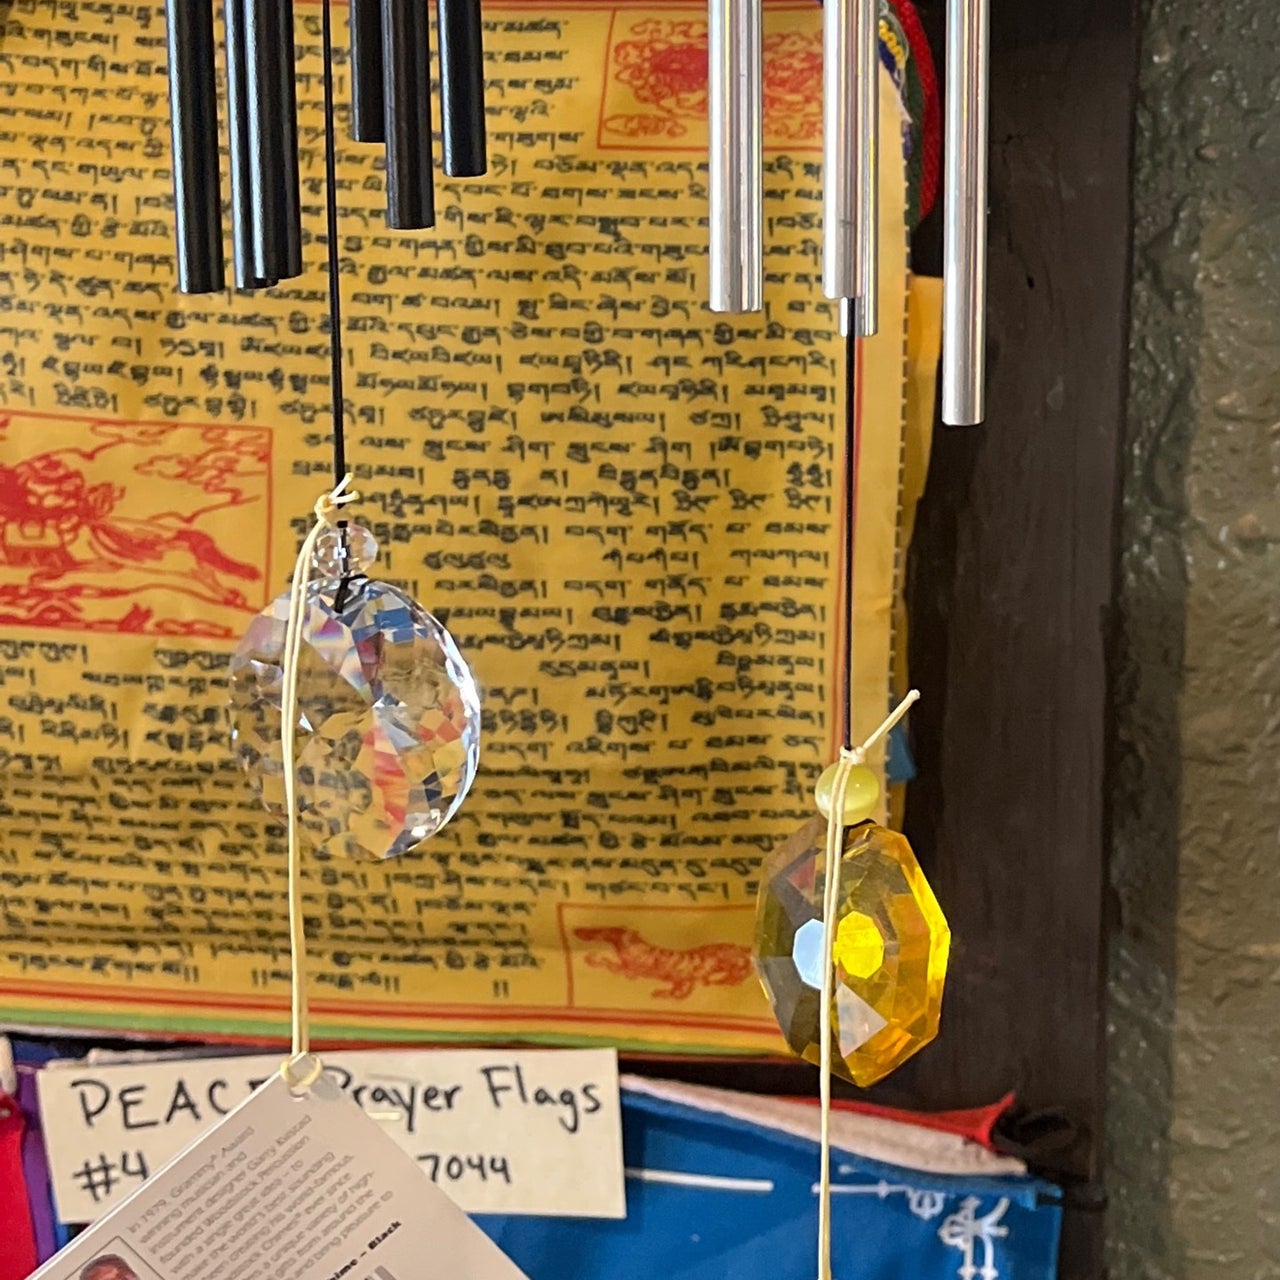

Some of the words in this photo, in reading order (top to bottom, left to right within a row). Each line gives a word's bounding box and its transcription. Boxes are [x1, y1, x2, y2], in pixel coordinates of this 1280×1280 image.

[70, 1078, 265, 1130] PEAC
[480, 1063, 602, 1133] Flags
[417, 1153, 512, 1183] 7044
